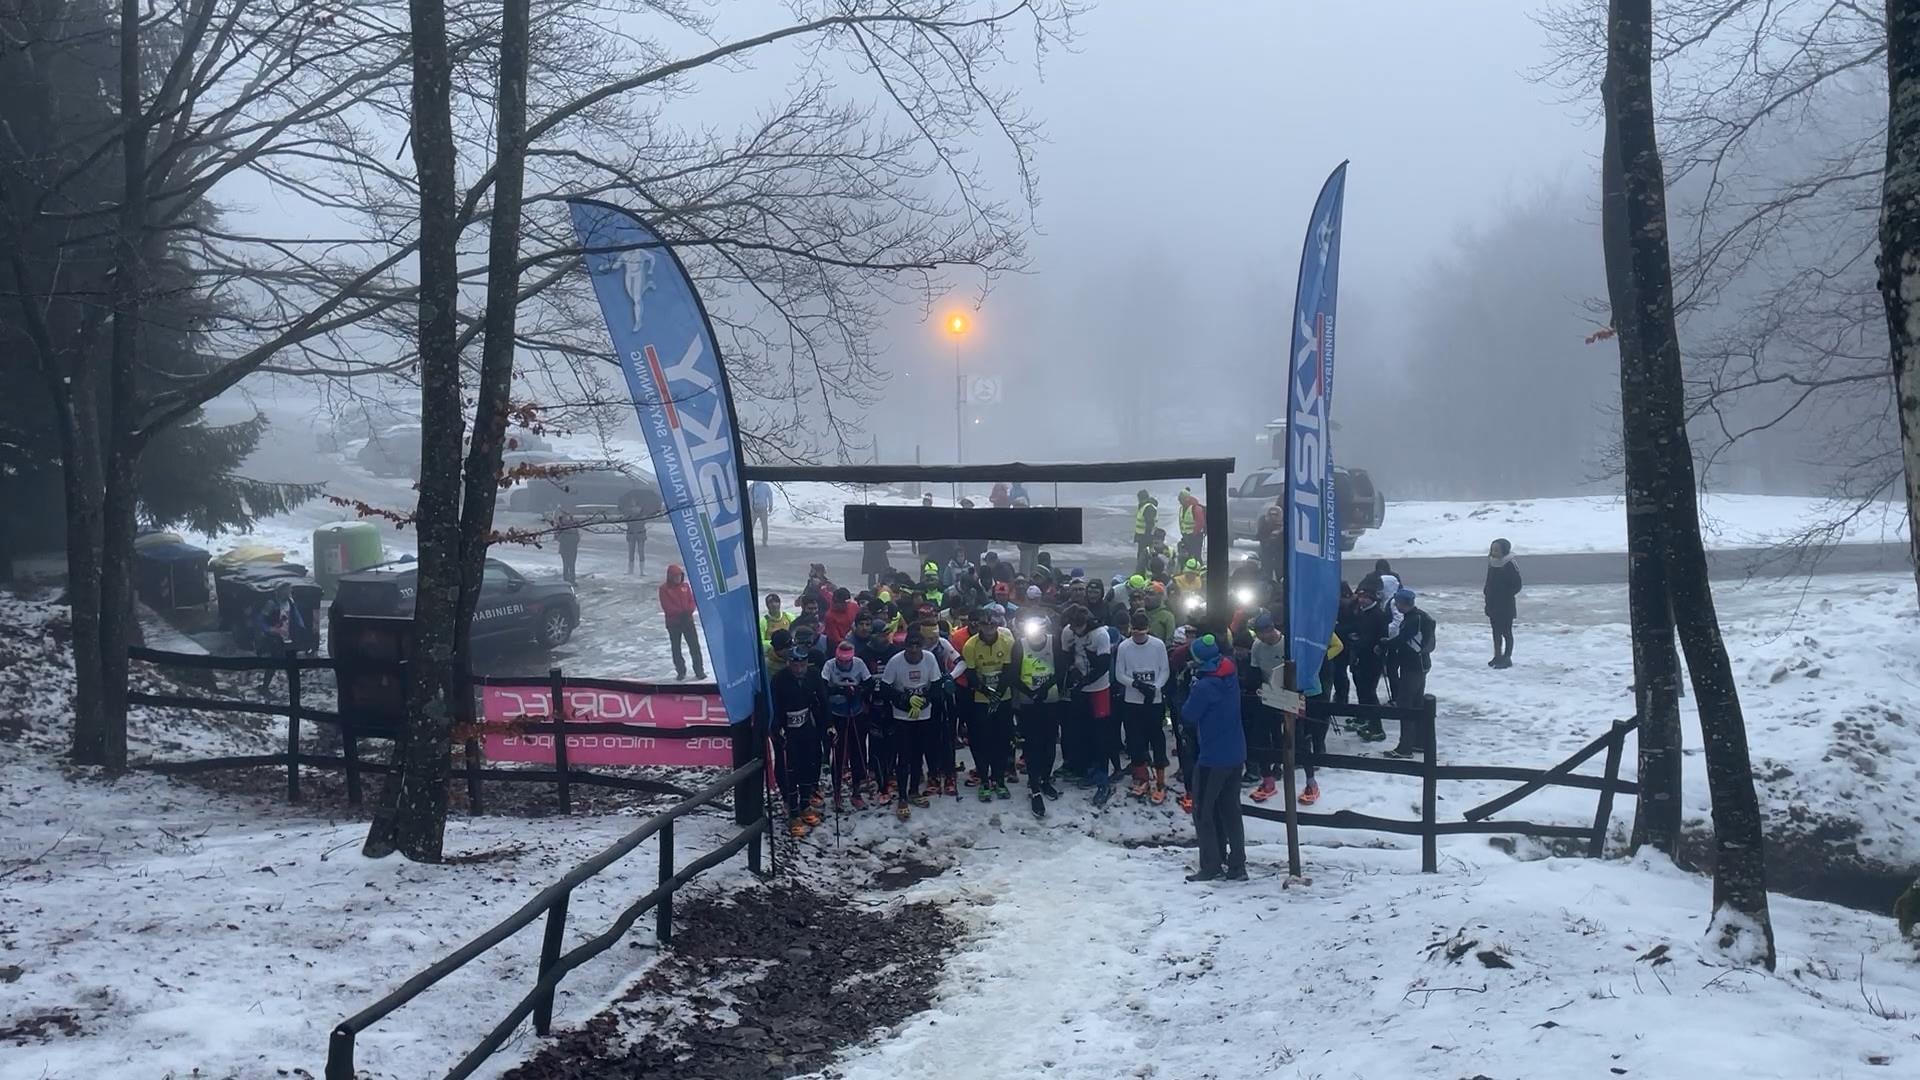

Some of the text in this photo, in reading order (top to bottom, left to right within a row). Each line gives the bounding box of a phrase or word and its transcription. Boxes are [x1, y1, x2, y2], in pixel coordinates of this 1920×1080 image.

[1294, 308, 1320, 558] FISKY
[472, 603, 524, 622] RABINIERI
[1135, 673, 1153, 682] 214
